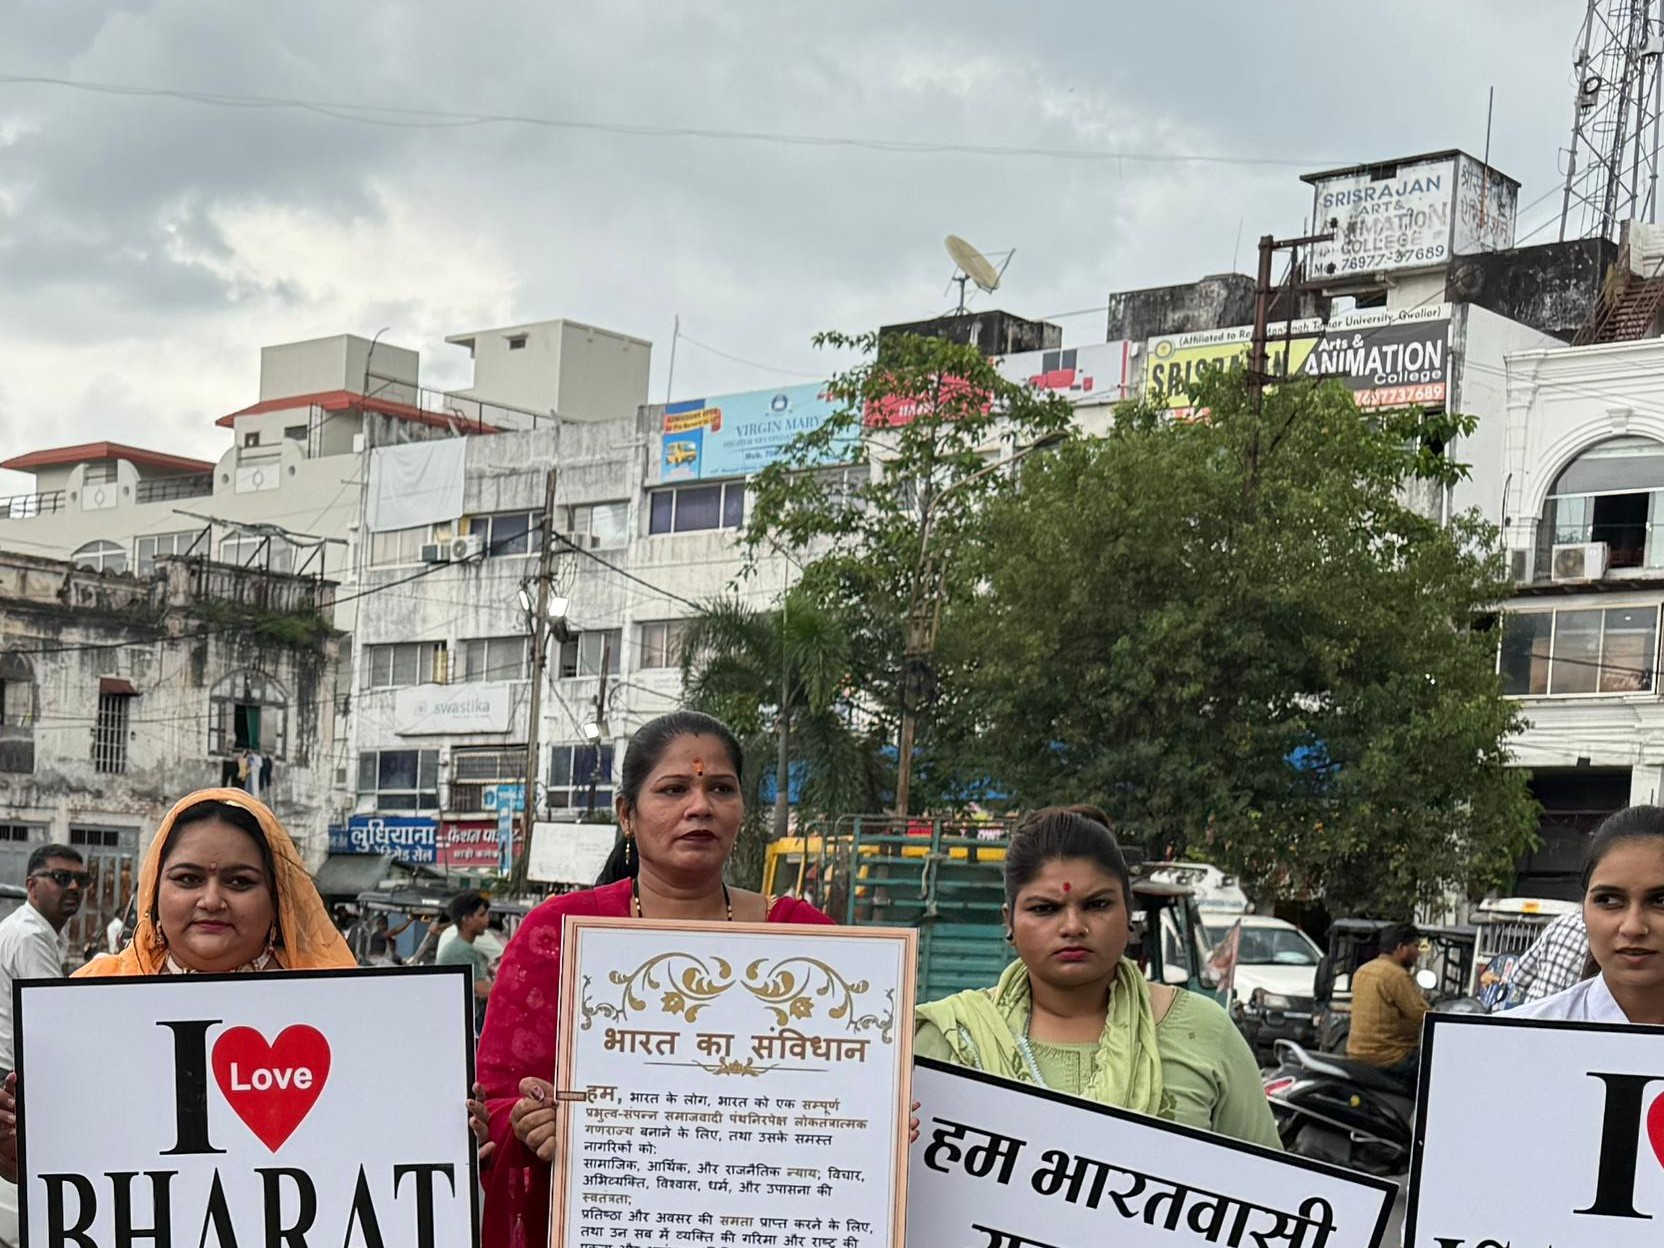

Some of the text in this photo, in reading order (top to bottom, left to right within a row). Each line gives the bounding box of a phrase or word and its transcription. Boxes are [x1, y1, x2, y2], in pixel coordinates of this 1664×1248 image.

[1323, 175, 1441, 208] SRISRAJAN
[1312, 319, 1341, 332] Toar
[1318, 333, 1364, 351] Arts &
[1305, 340, 1442, 377] ANIMATION
[1374, 369, 1443, 385] College
[736, 415, 822, 437] VIRGIN MARY
[434, 698, 490, 714] swastika
[351, 818, 436, 852] लुधियाना
[604, 1026, 871, 1063] भारत का संविधान
[156, 1019, 313, 1155] I Love
[630, 1092, 660, 1104] भारत
[666, 1091, 678, 1104] के
[718, 1096, 749, 1107] भारत
[754, 1095, 770, 1108] को
[776, 1099, 796, 1109] एक
[801, 1098, 840, 1116] सम्पूर्ण
[664, 1110, 723, 1124] समाजवादी
[729, 1111, 788, 1126] पंथनिरपेक्ष
[585, 1125, 635, 1136] गणराज्य
[640, 1125, 672, 1138] बनाने
[677, 1126, 690, 1139] के
[728, 1131, 753, 1141] तथा
[758, 1130, 789, 1143] उसके
[794, 1134, 833, 1145] समस्त
[1573, 1071, 1664, 1219] I
[584, 1139, 633, 1154] नागरिकों
[923, 1116, 1026, 1185] हम
[697, 1161, 720, 1174] और
[725, 1163, 782, 1177] राजनैतिक
[738, 1180, 761, 1194] और
[766, 1184, 811, 1195] उपासना
[817, 1183, 833, 1197] की
[581, 1206, 623, 1221] प्रतिष्ठा
[628, 1208, 650, 1222] और
[656, 1212, 693, 1224] अवसर
[698, 1212, 714, 1225] की
[720, 1216, 754, 1227] समता
[760, 1218, 788, 1229] प्राप्त
[794, 1217, 822, 1230] करने
[828, 1218, 840, 1231] के
[581, 1226, 604, 1237] तथा
[610, 1228, 628, 1238] उन
[634, 1229, 654, 1239] सब
[659, 1227, 670, 1240] में
[676, 1228, 715, 1242] व्यक्ति
[720, 1230, 736, 1243] की
[742, 1231, 778, 1245] गरिमा
[783, 1233, 806, 1247] और
[843, 1236, 859, 1248] की
